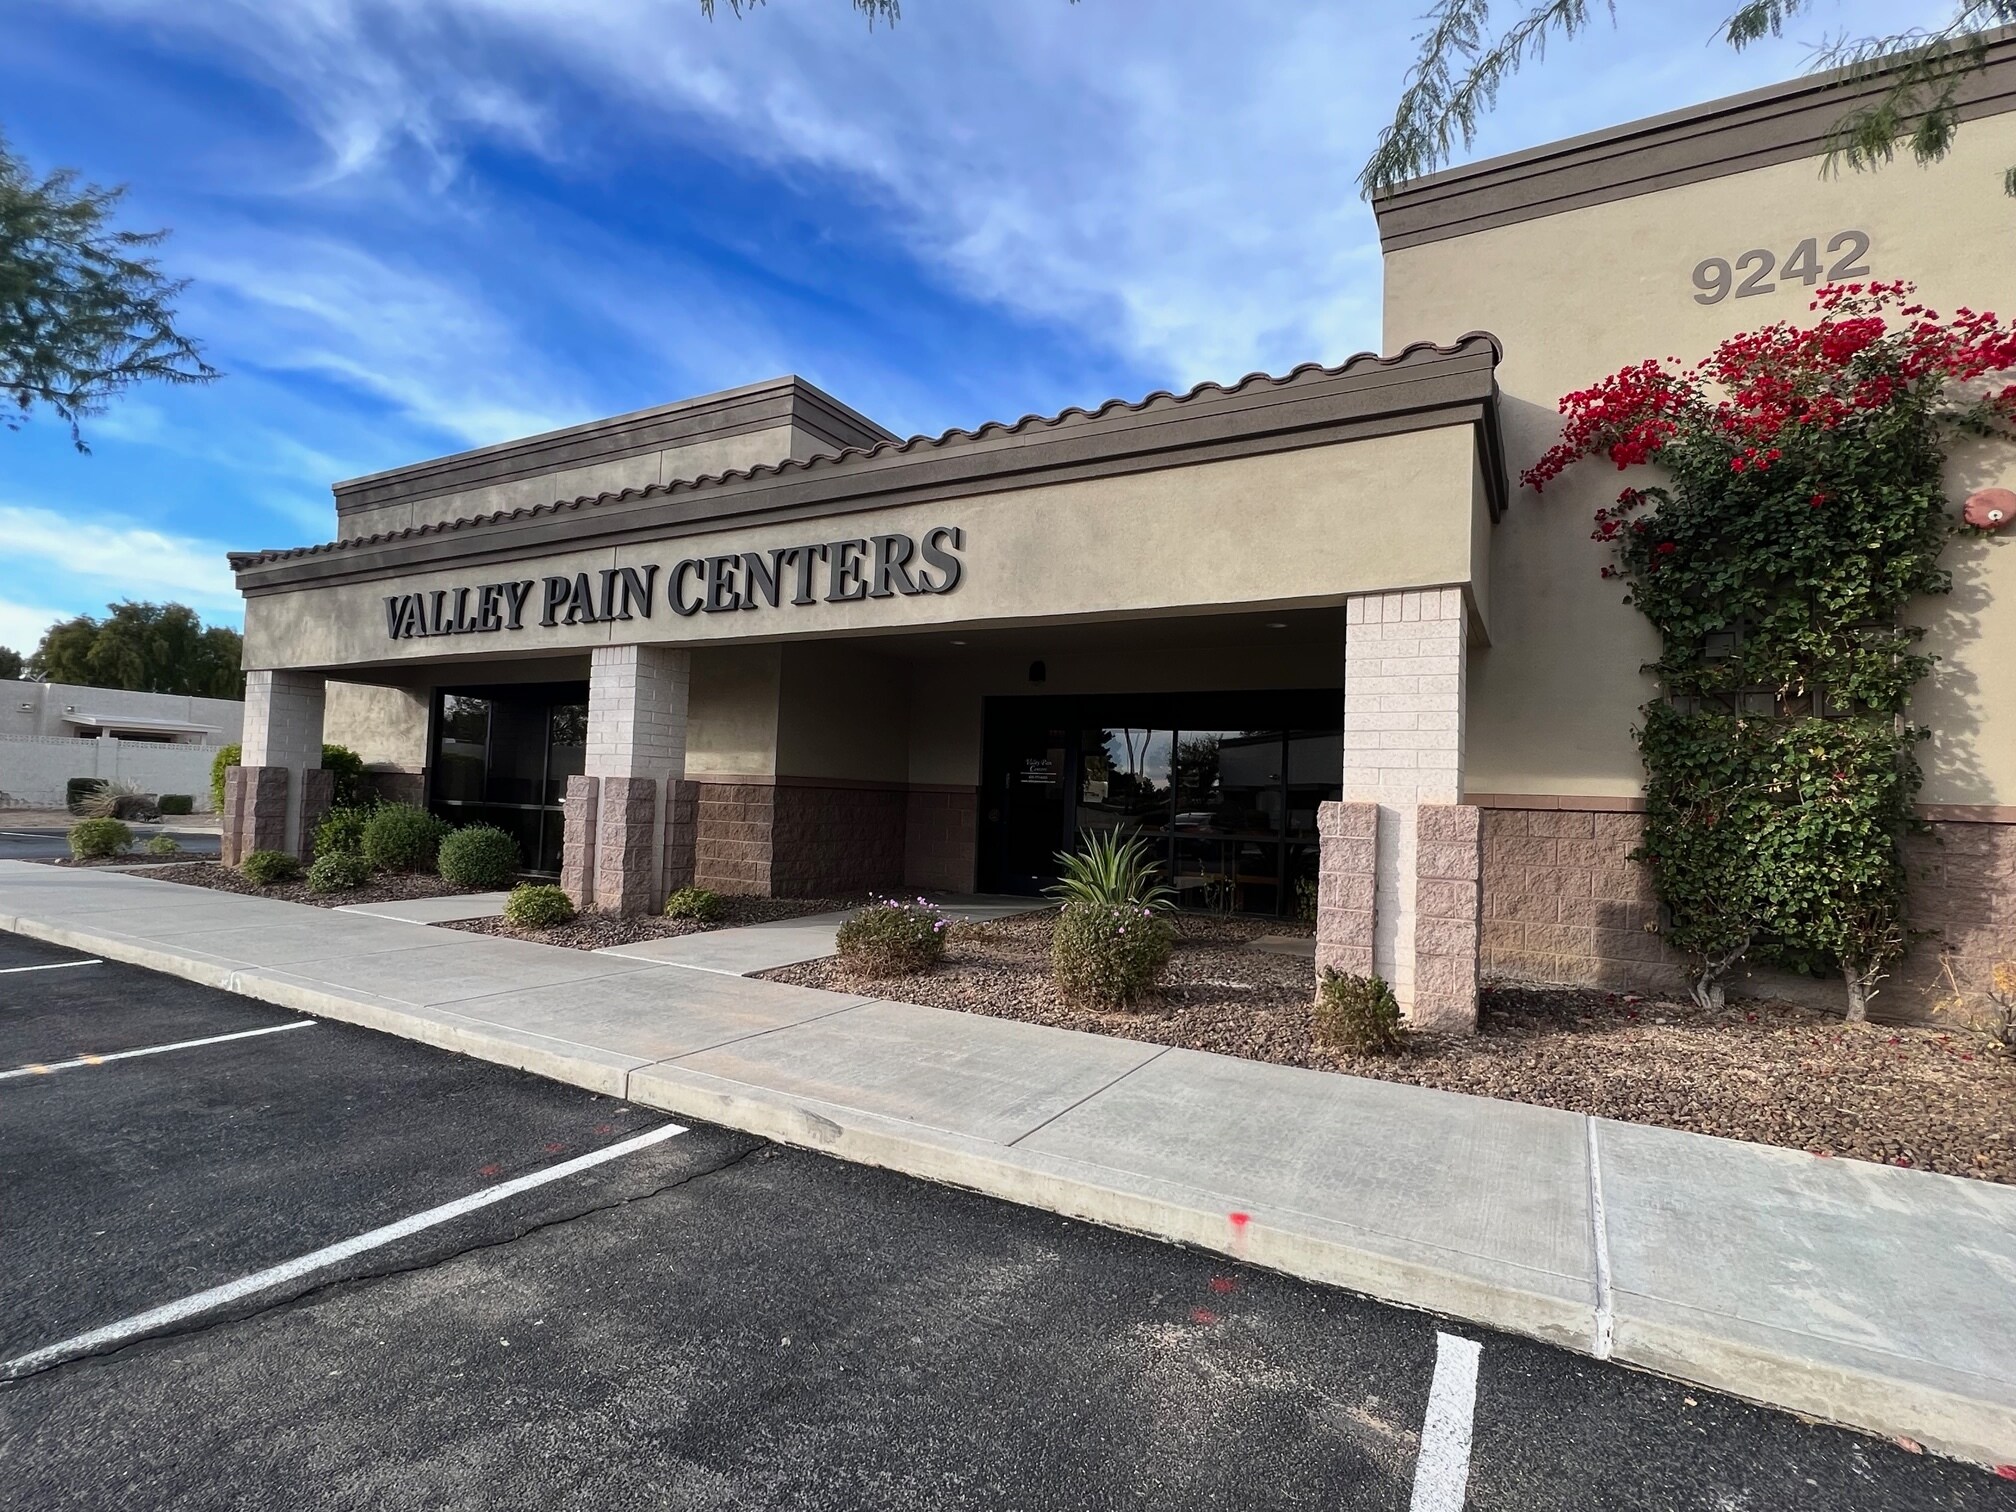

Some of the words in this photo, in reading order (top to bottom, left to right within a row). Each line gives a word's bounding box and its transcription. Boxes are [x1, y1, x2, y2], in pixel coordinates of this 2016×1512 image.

[1692, 230, 1870, 305] 9242
[383, 580, 532, 640] VALLEY
[540, 564, 660, 627] PAIN
[668, 527, 966, 617] CENTERS
